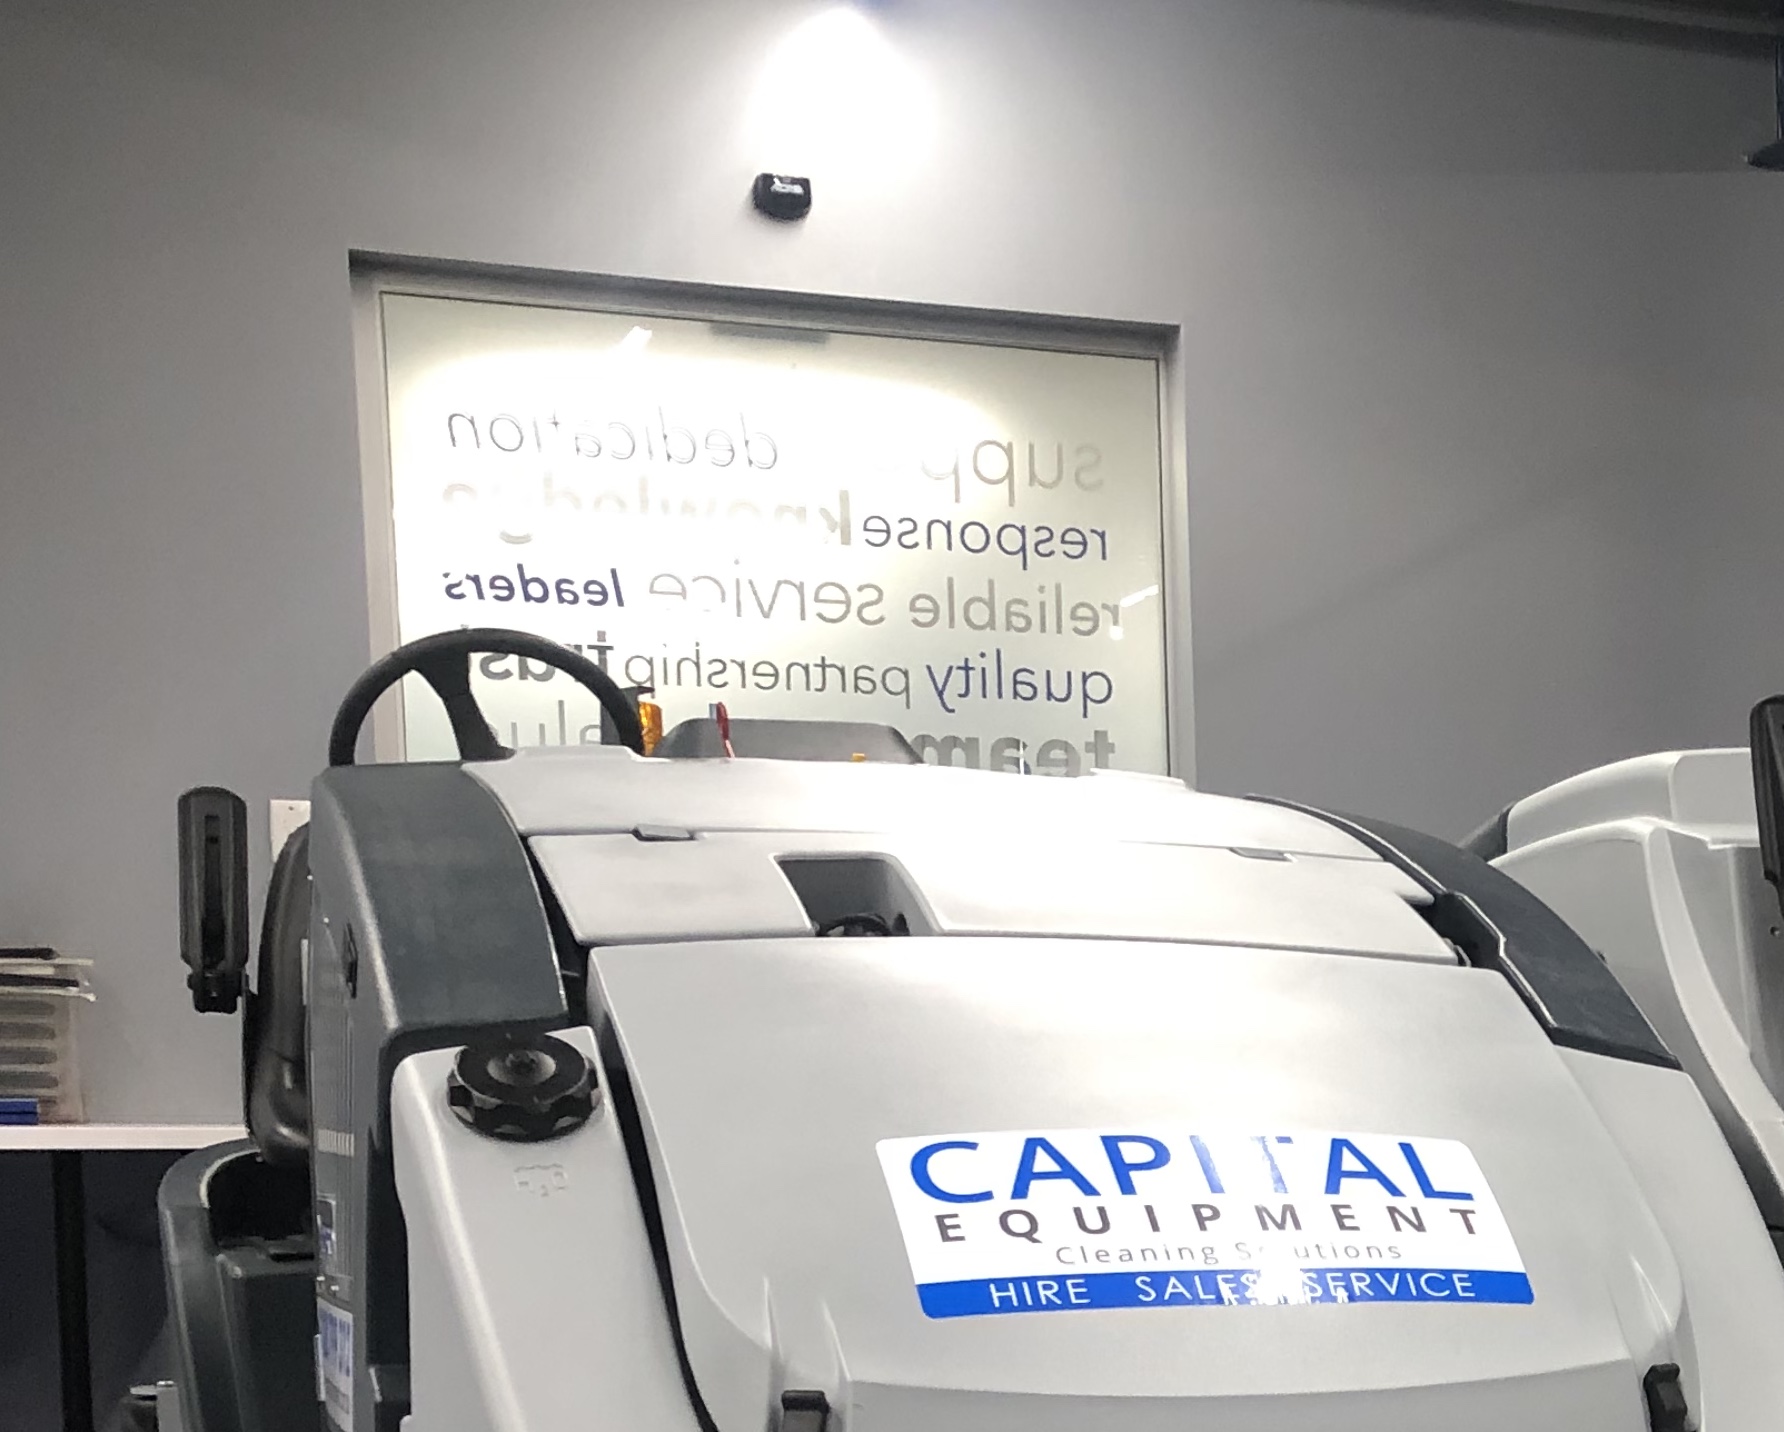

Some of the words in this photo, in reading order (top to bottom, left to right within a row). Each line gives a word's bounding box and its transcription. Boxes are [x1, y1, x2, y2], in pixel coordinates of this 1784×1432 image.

[909, 1134, 1476, 1204] CAPITAL
[934, 1202, 1478, 1244] EQUIPMENT
[1056, 1241, 1220, 1267] Cleaning
[1233, 1240, 1403, 1261] Sutions
[990, 1279, 1091, 1308] HIRE
[1138, 1272, 1259, 1304] SALES
[1302, 1270, 1477, 1300] SERVICE
